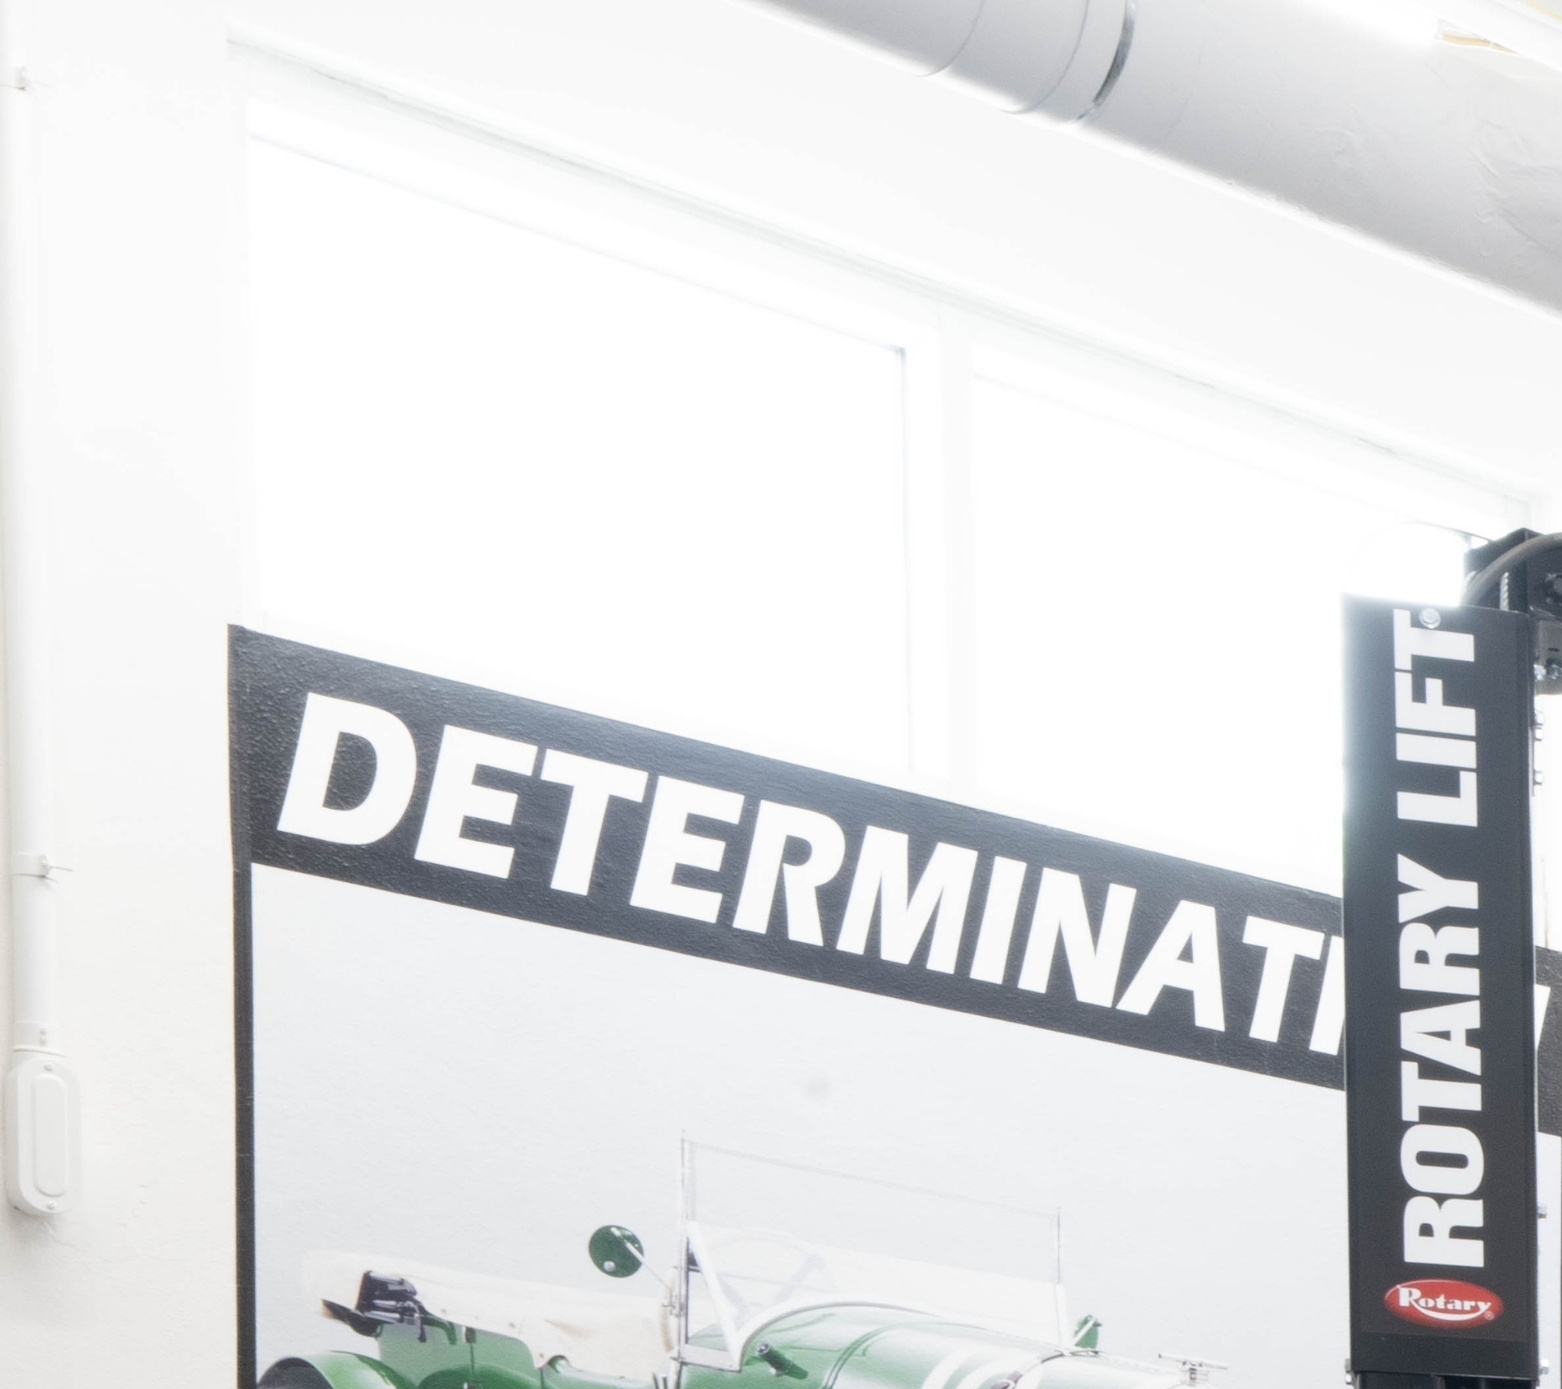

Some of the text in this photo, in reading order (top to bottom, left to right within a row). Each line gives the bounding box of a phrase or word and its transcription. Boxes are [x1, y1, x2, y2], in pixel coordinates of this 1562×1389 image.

[1393, 609, 1485, 1268] ROTARY LIFT
[1398, 1285, 1492, 1316] Rotary
